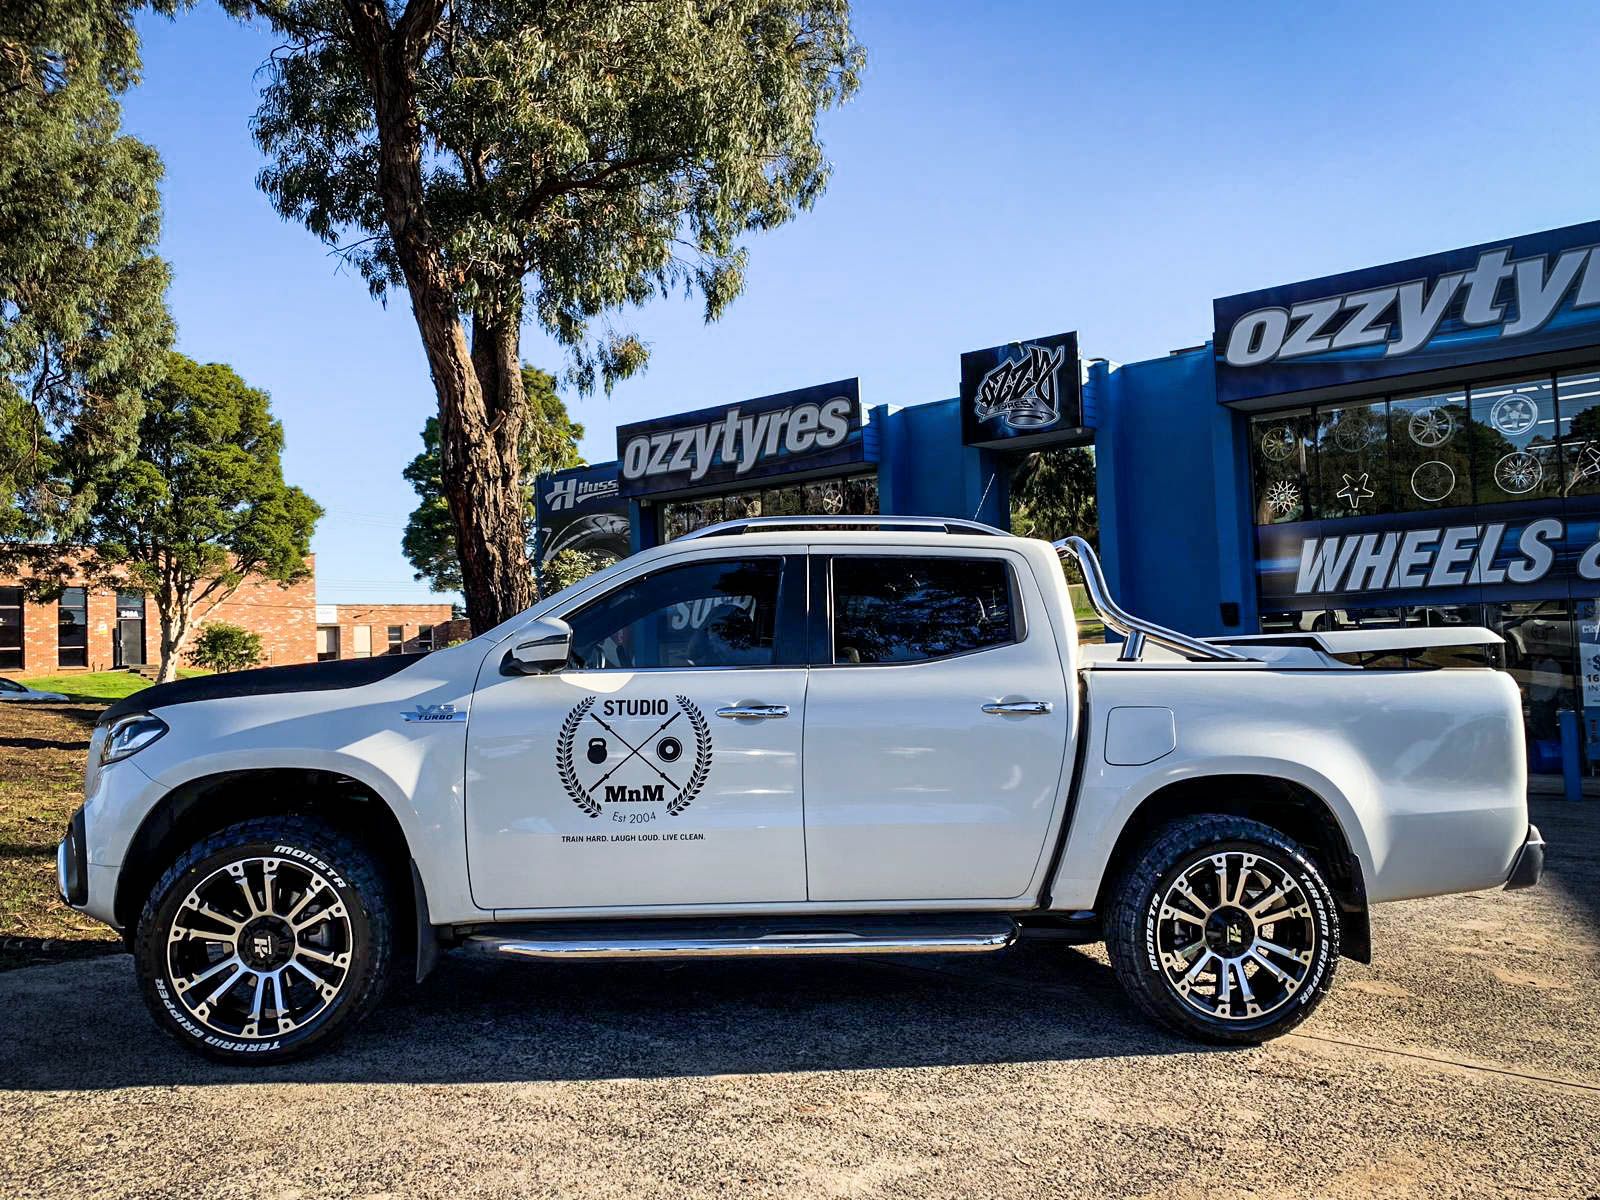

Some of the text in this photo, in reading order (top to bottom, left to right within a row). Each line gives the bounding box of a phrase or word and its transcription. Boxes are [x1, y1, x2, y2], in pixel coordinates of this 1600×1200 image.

[623, 397, 851, 481] ozzytyres
[1296, 518, 1563, 593] WHEELS
[603, 699, 669, 717] STUDIO
[604, 784, 665, 803] MnM
[612, 811, 656, 824] Est 2004
[273, 845, 347, 889] MONSTA
[561, 833, 706, 843] TRAIN HARD. LAUGH LOUD. LIVE CLEAN.
[1146, 892, 1161, 972] MONSTA
[1299, 872, 1329, 1005] TERRAIN GRIPPER
[154, 978, 281, 1053] TERRAIN GRIPPER
